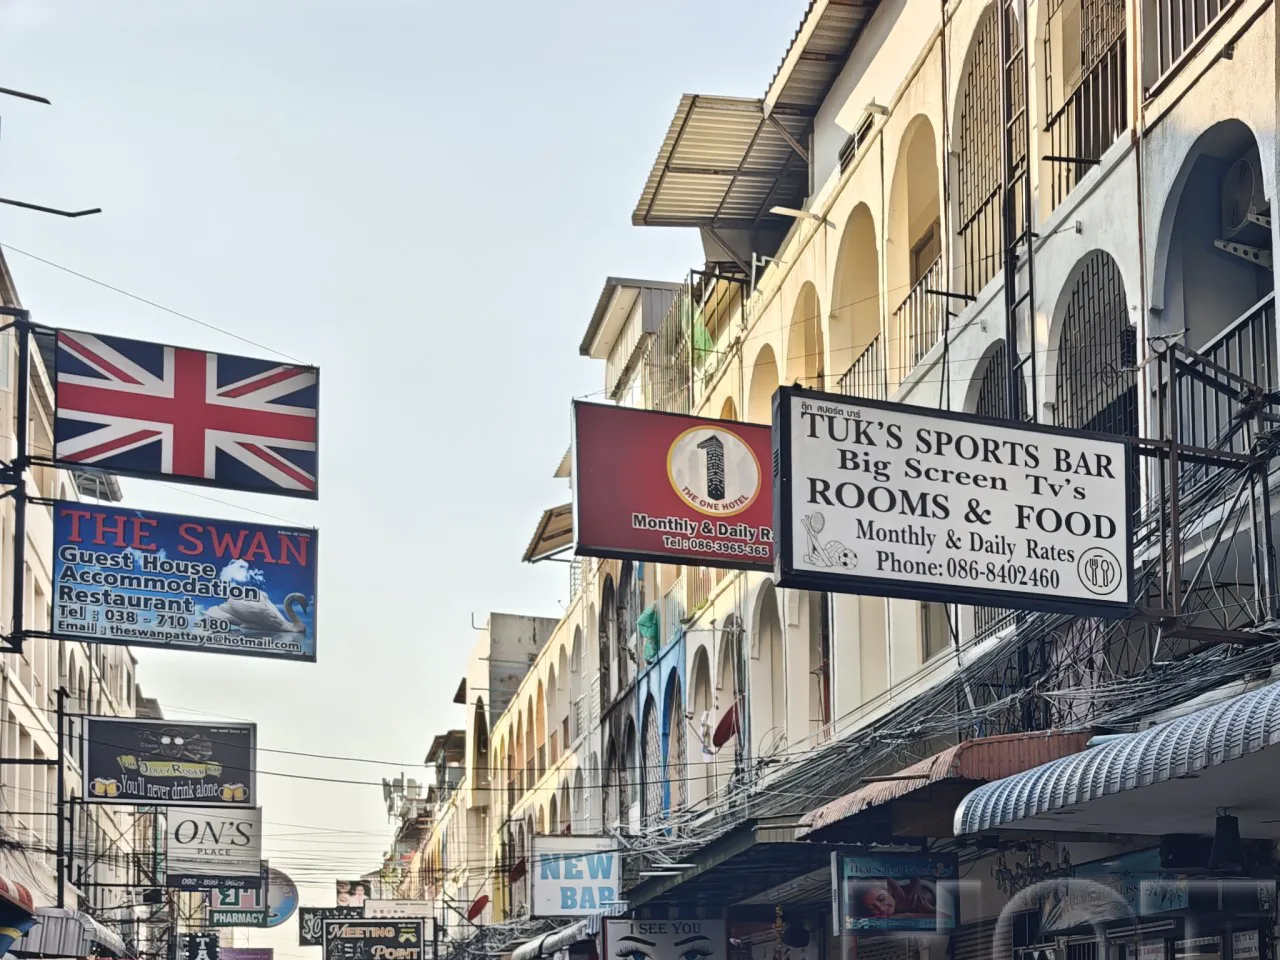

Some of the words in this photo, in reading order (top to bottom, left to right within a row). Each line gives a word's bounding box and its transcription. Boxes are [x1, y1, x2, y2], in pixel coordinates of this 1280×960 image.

[801, 412, 903, 450] TUK'S
[916, 428, 1040, 469] SPORTS
[1053, 448, 1116, 479] BAR
[837, 448, 892, 482] Big
[904, 458, 1008, 491] Screen
[1025, 474, 1086, 500] Tv's
[682, 486, 698, 502] THE
[700, 500, 720, 511] ONE
[722, 494, 750, 511] HOTEL
[806, 477, 950, 520] ROOMS
[964, 498, 992, 525] &
[1015, 504, 1116, 539] FOOD
[61, 510, 158, 551] THE
[177, 524, 310, 566] SWAN
[632, 513, 698, 536] Monthly
[702, 522, 714, 536] &
[718, 522, 757, 542] Daily
[760, 528, 774, 542] R
[856, 518, 936, 554] Monthly
[946, 529, 962, 550] &
[969, 532, 1016, 563] Daily
[1026, 538, 1075, 562] Rates
[664, 536, 681, 548] Tel
[59, 546, 134, 570] Guest
[143, 554, 216, 578] House
[60, 566, 260, 602] Accommodation
[59, 586, 195, 616] Restaurant
[59, 605, 84, 620] Tel
[104, 611, 138, 623] 038
[157, 615, 187, 628] 710
[59, 621, 97, 634] Email
[110, 624, 300, 652] theswanpattaya@hotmail.com
[122, 775, 145, 796] You'll
[147, 781, 170, 800] never
[172, 780, 194, 799] drink
[196, 780, 218, 796] alone
[174, 820, 252, 846] ON'S
[197, 848, 231, 856] PLACE
[540, 852, 614, 880] NEW
[560, 886, 615, 910] BAR
[213, 912, 264, 924] PHARMACY
[328, 923, 396, 939] MEETING
[630, 924, 636, 935] I
[638, 923, 668, 936] SEE
[672, 922, 702, 935] YOU
[371, 945, 420, 960] POINT
